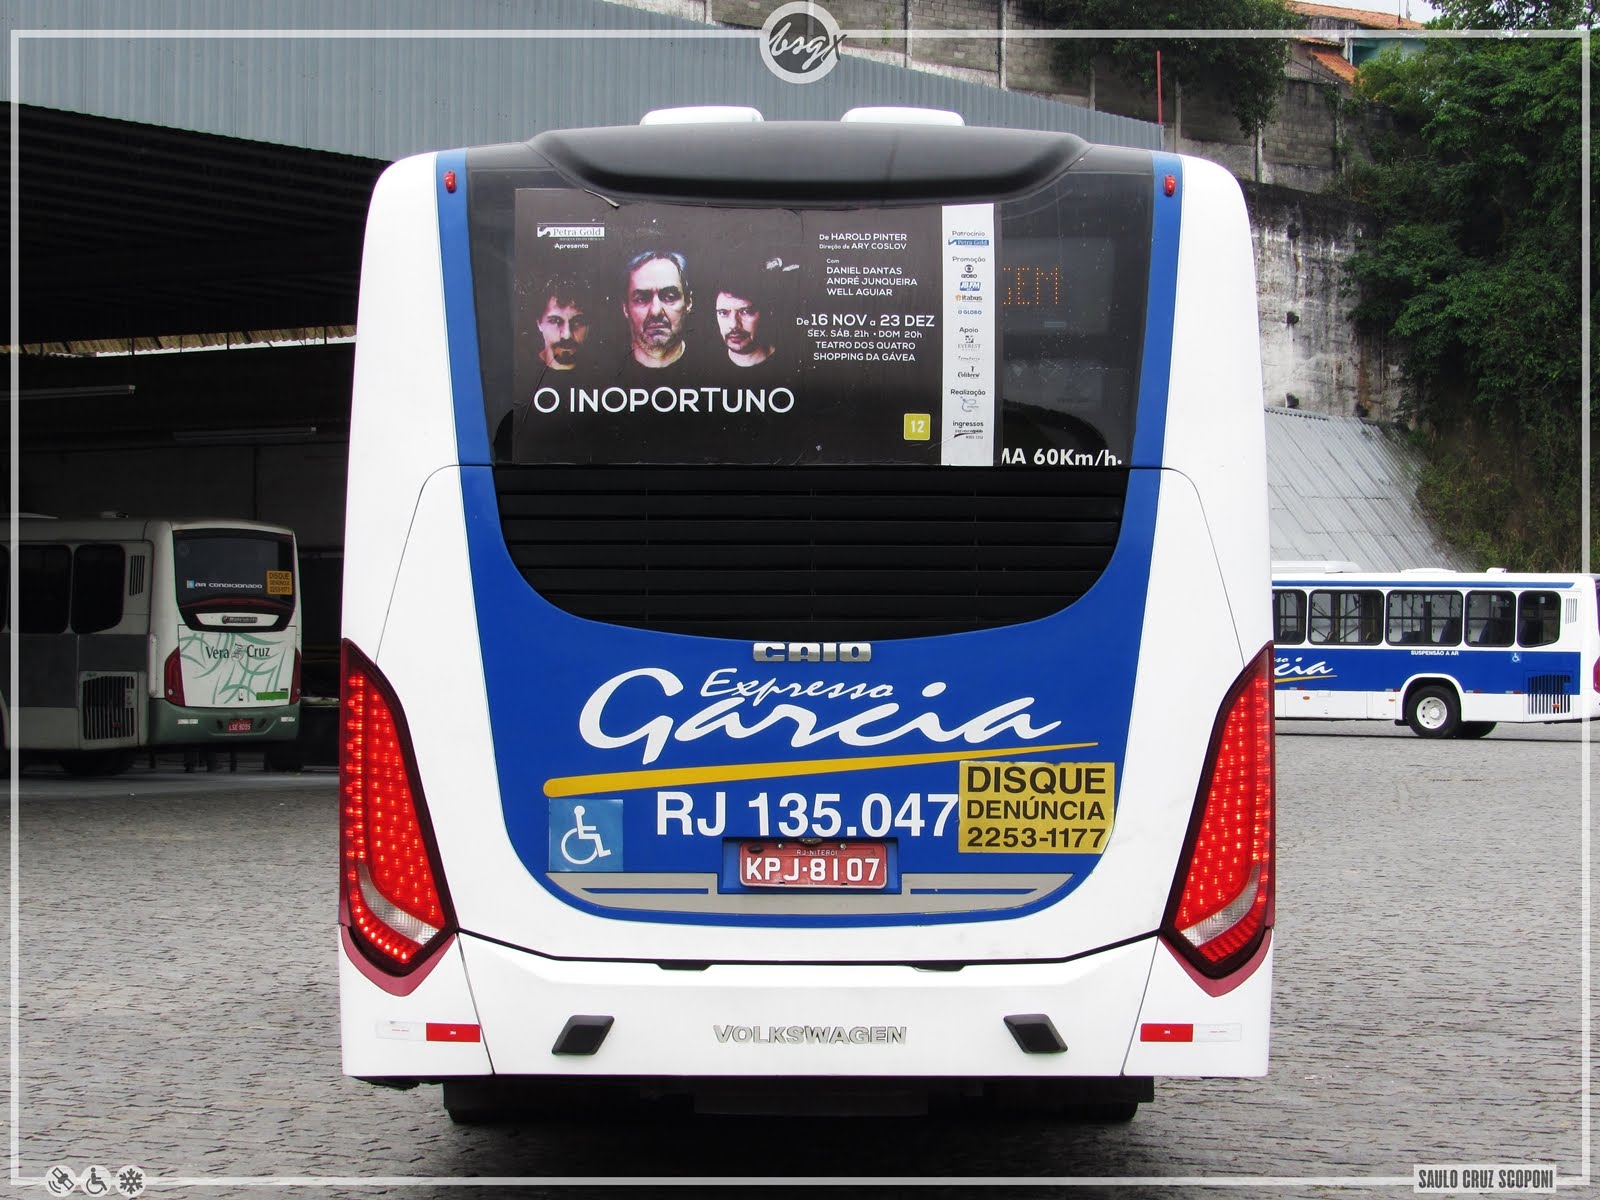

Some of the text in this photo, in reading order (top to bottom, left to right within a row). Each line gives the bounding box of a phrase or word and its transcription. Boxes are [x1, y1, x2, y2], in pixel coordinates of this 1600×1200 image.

[553, 228, 601, 236] Petra Gold
[831, 233, 871, 241] HAROLD
[873, 233, 907, 241] PINTER
[827, 267, 902, 275] DANIEL DANTAS
[827, 276, 918, 286] ANDRÉ JUNQUEIRA
[827, 288, 893, 296] WELL AGUIAR
[796, 318, 809, 326] De
[811, 314, 828, 326] 16
[832, 314, 867, 326] NOV
[880, 315, 900, 327] 23
[904, 315, 935, 327] DEZ
[807, 330, 828, 338] SEX.
[854, 330, 869, 338] 21h
[878, 330, 900, 338] DOM
[904, 331, 922, 339] 20h
[959, 327, 979, 335] Apoio
[815, 341, 852, 349] TEATRO
[877, 342, 916, 350] QUATRO
[813, 351, 915, 361] SHOPPING DA GÁVEA
[533, 387, 795, 413] O INOPORTUNO
[911, 420, 925, 432] 12
[206, 646, 230, 660] Vera
[246, 644, 270, 657] Cruz
[753, 642, 872, 662] CAIO
[700, 667, 894, 705] Expresso
[579, 667, 1061, 765] Garcia
[966, 768, 1106, 795] DISQUE
[966, 795, 1106, 821] DENÚNCIA
[657, 792, 959, 838] RJ 135.047
[966, 827, 1105, 849] 2253-1177
[713, 1025, 907, 1045] VOLKSWAGEN
